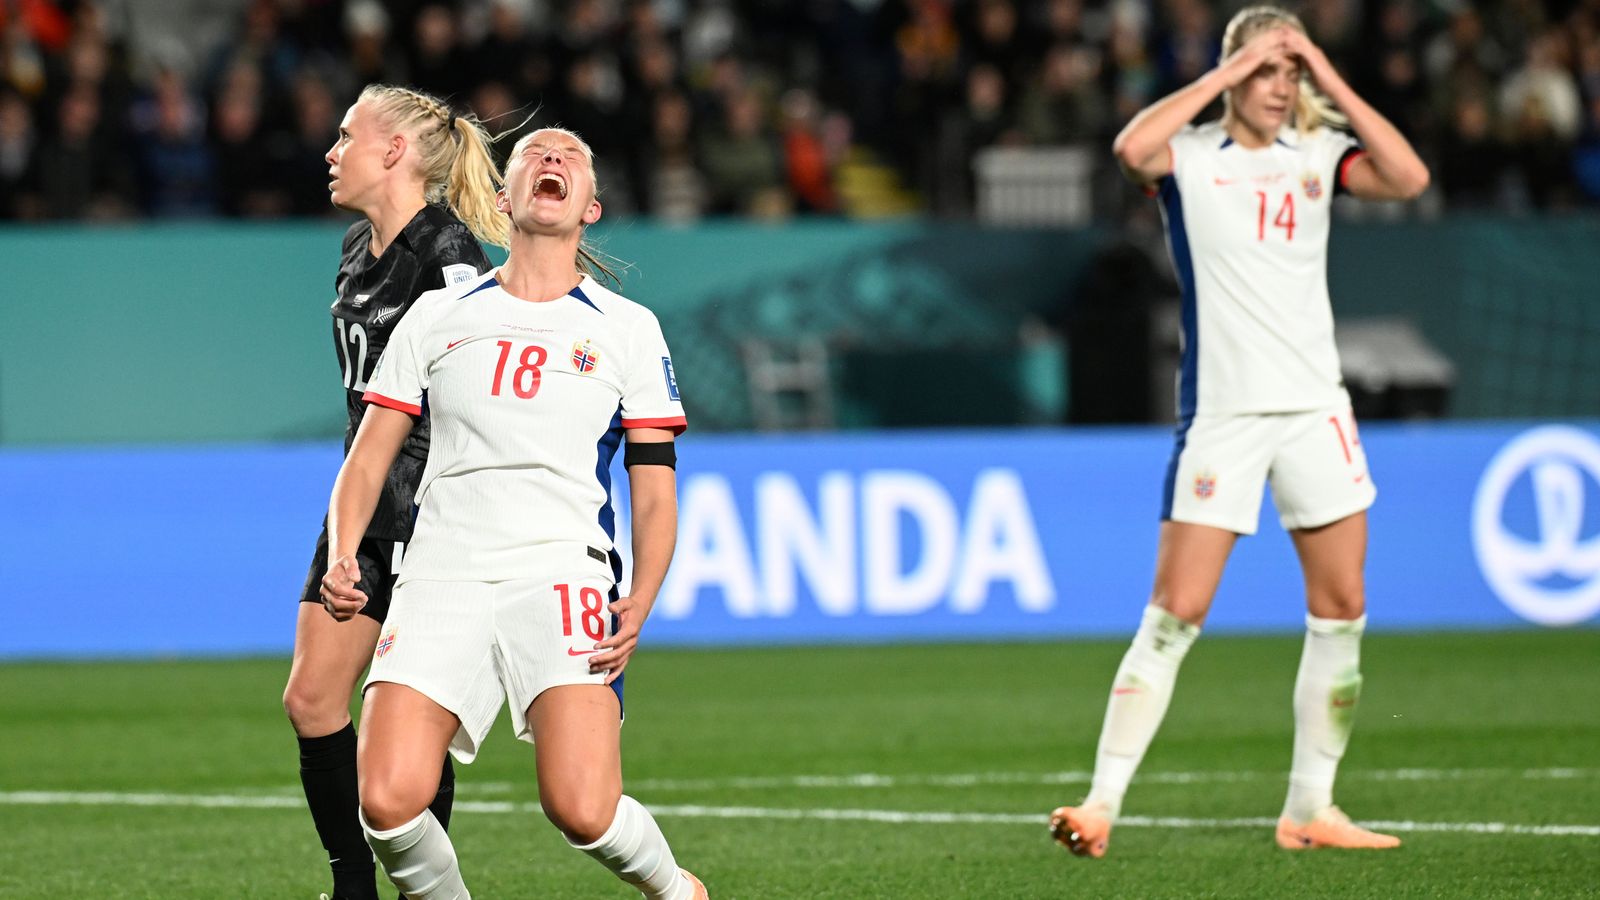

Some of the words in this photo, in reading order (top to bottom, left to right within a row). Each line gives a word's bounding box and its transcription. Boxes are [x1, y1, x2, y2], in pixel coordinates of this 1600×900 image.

[1255, 190, 1297, 242] 14
[336, 317, 368, 392] 12
[490, 340, 548, 400] 18
[611, 469, 1056, 618] ANDA
[553, 583, 605, 642] 18
